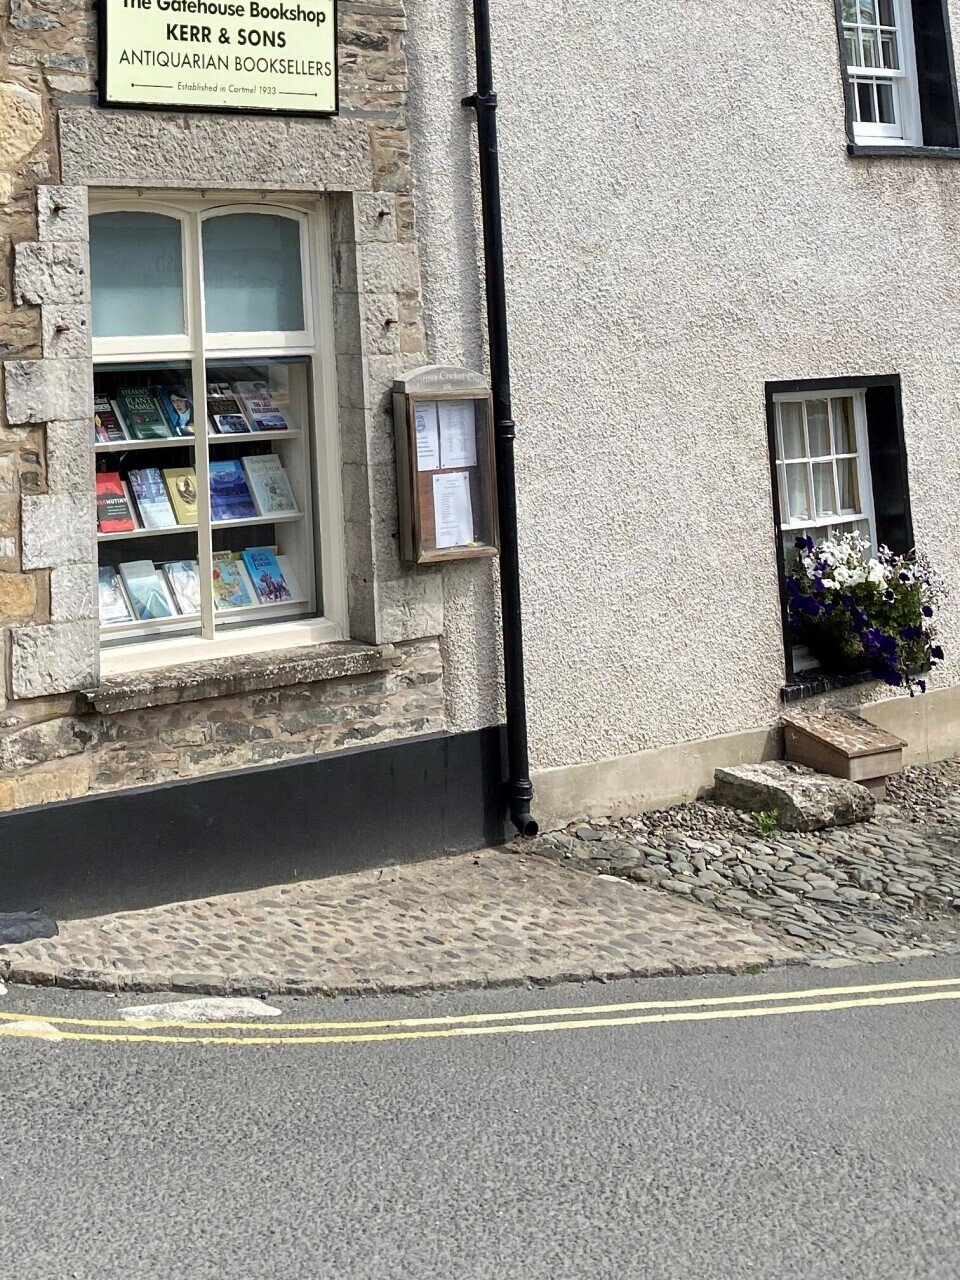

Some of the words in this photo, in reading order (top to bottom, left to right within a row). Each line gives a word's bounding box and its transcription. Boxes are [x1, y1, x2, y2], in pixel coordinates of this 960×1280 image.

[249, 1, 327, 27] Bookshop
[166, 23, 212, 43] KERR
[218, 27, 231, 45] &
[237, 28, 287, 48] SONS
[119, 48, 229, 71] ANTIQUARIAN
[235, 56, 332, 77] BOOKSELLERS
[177, 81, 218, 93] Established
[220, 84, 227, 93] in
[228, 84, 257, 95] Cartmel
[259, 85, 277, 96] 1933
[128, 403, 155, 411] NAMES
